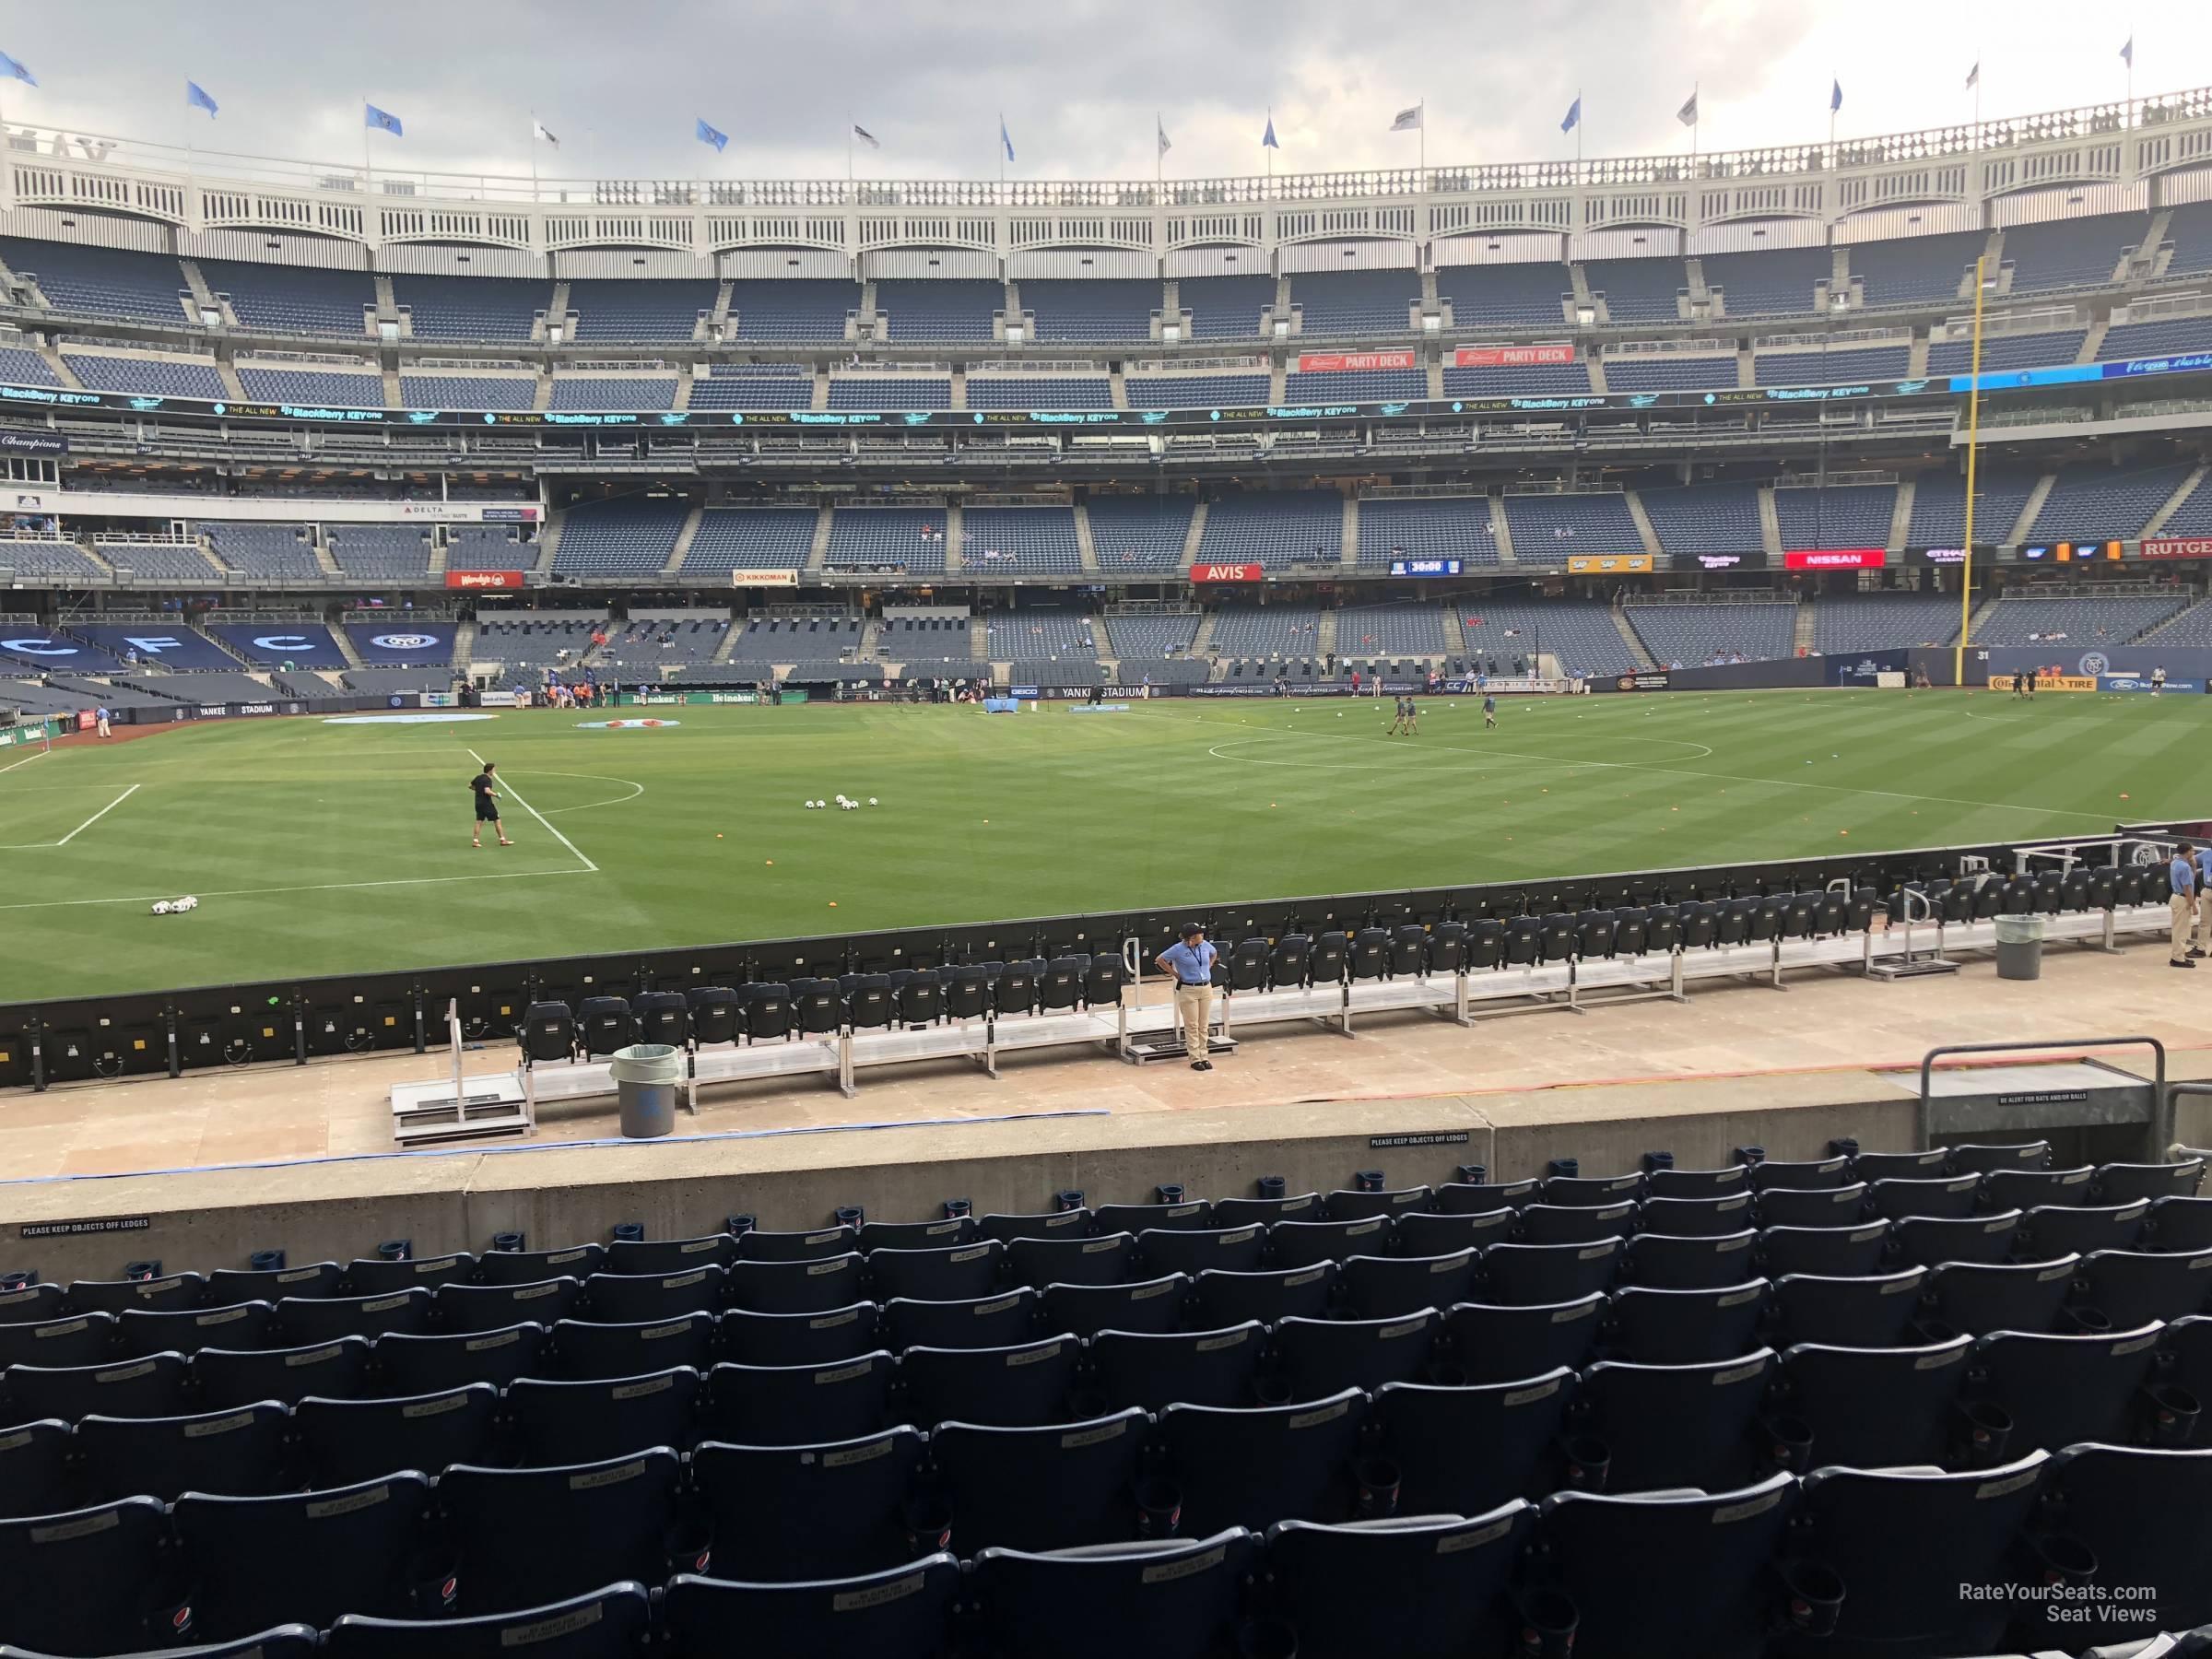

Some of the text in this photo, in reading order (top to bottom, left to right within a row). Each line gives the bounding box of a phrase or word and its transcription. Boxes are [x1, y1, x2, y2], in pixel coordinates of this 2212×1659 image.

[1346, 353, 1376, 367] PARTY
[1380, 351, 1407, 365] DECK
[1503, 348, 1535, 362] PARTY
[1538, 347, 1567, 360] DECK
[246, 406, 257, 415] ALL
[259, 406, 277, 415] NEW
[499, 415, 541, 423] THE ALL NEW
[1, 435, 62, 449] Champions
[1806, 555, 1862, 564] NISSAN
[1411, 560, 1441, 571] 30:00
[1206, 567, 1244, 579] AVIS
[461, 573, 491, 586] Wendy's
[124, 637, 183, 653] F
[252, 635, 316, 651] C
[712, 693, 754, 702] Heineken
[1063, 688, 1090, 697] YANK
[633, 695, 676, 703] Heneken
[200, 705, 273, 715] YANKEE STADIUM
[2025, 1095, 2035, 1103] FOR
[1446, 1134, 1467, 1142] LEDGES
[22, 1219, 148, 1235] PLEASE KEEP OBJECTS OFF LEDGES
